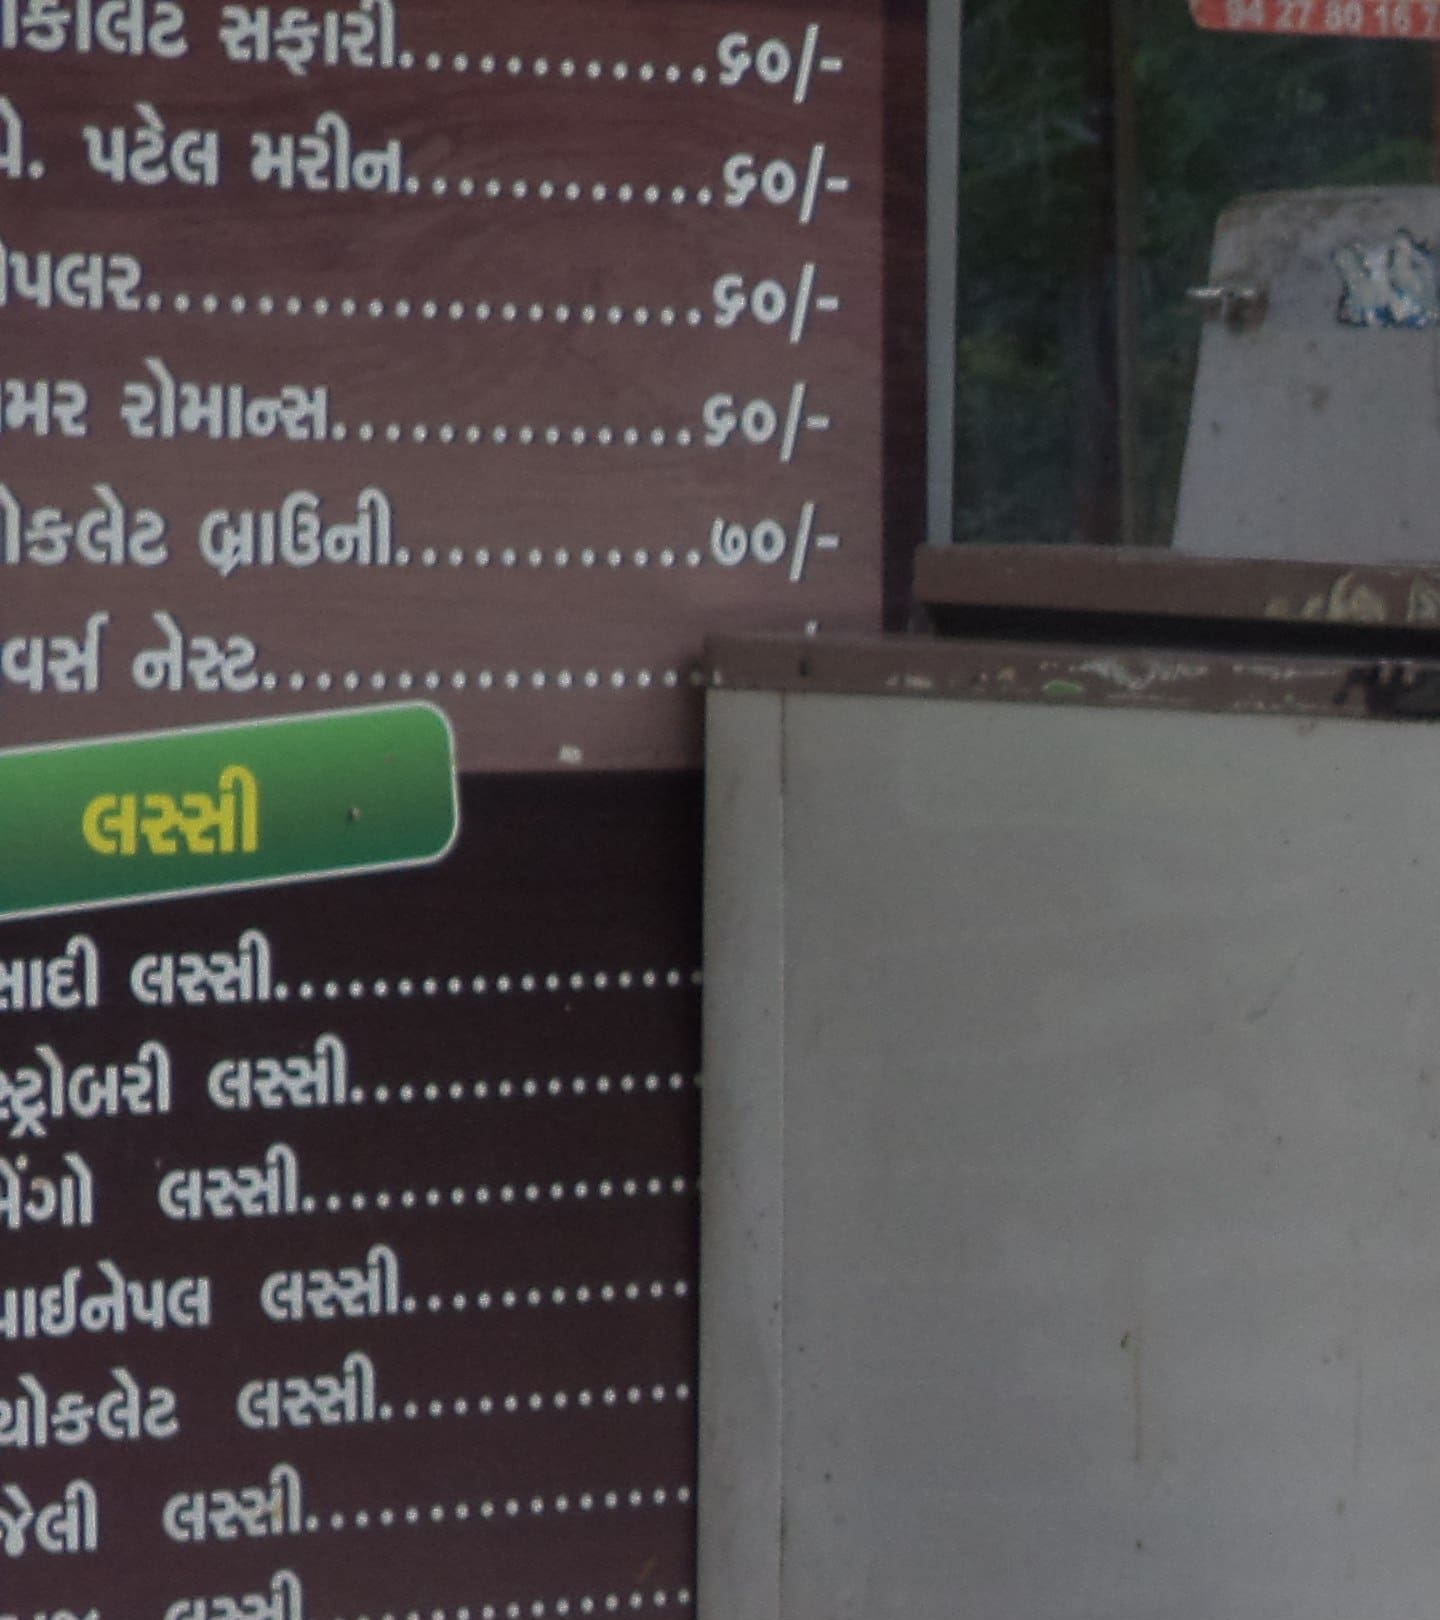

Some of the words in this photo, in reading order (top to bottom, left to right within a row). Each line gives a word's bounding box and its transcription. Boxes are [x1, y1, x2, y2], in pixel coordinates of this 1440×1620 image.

[81, 102, 219, 187] પટેલ
[250, 110, 402, 194] મરીન
[83, 765, 258, 855] લસ્સી
[129, 928, 272, 1005] લસ્સી
[206, 1033, 348, 1109] લસ્સી
[157, 1142, 299, 1220] લસ્સી
[259, 1243, 400, 1321] લસ્સી
[236, 1351, 376, 1430] લસ્સી
[161, 1462, 302, 1543] લસ્સી
